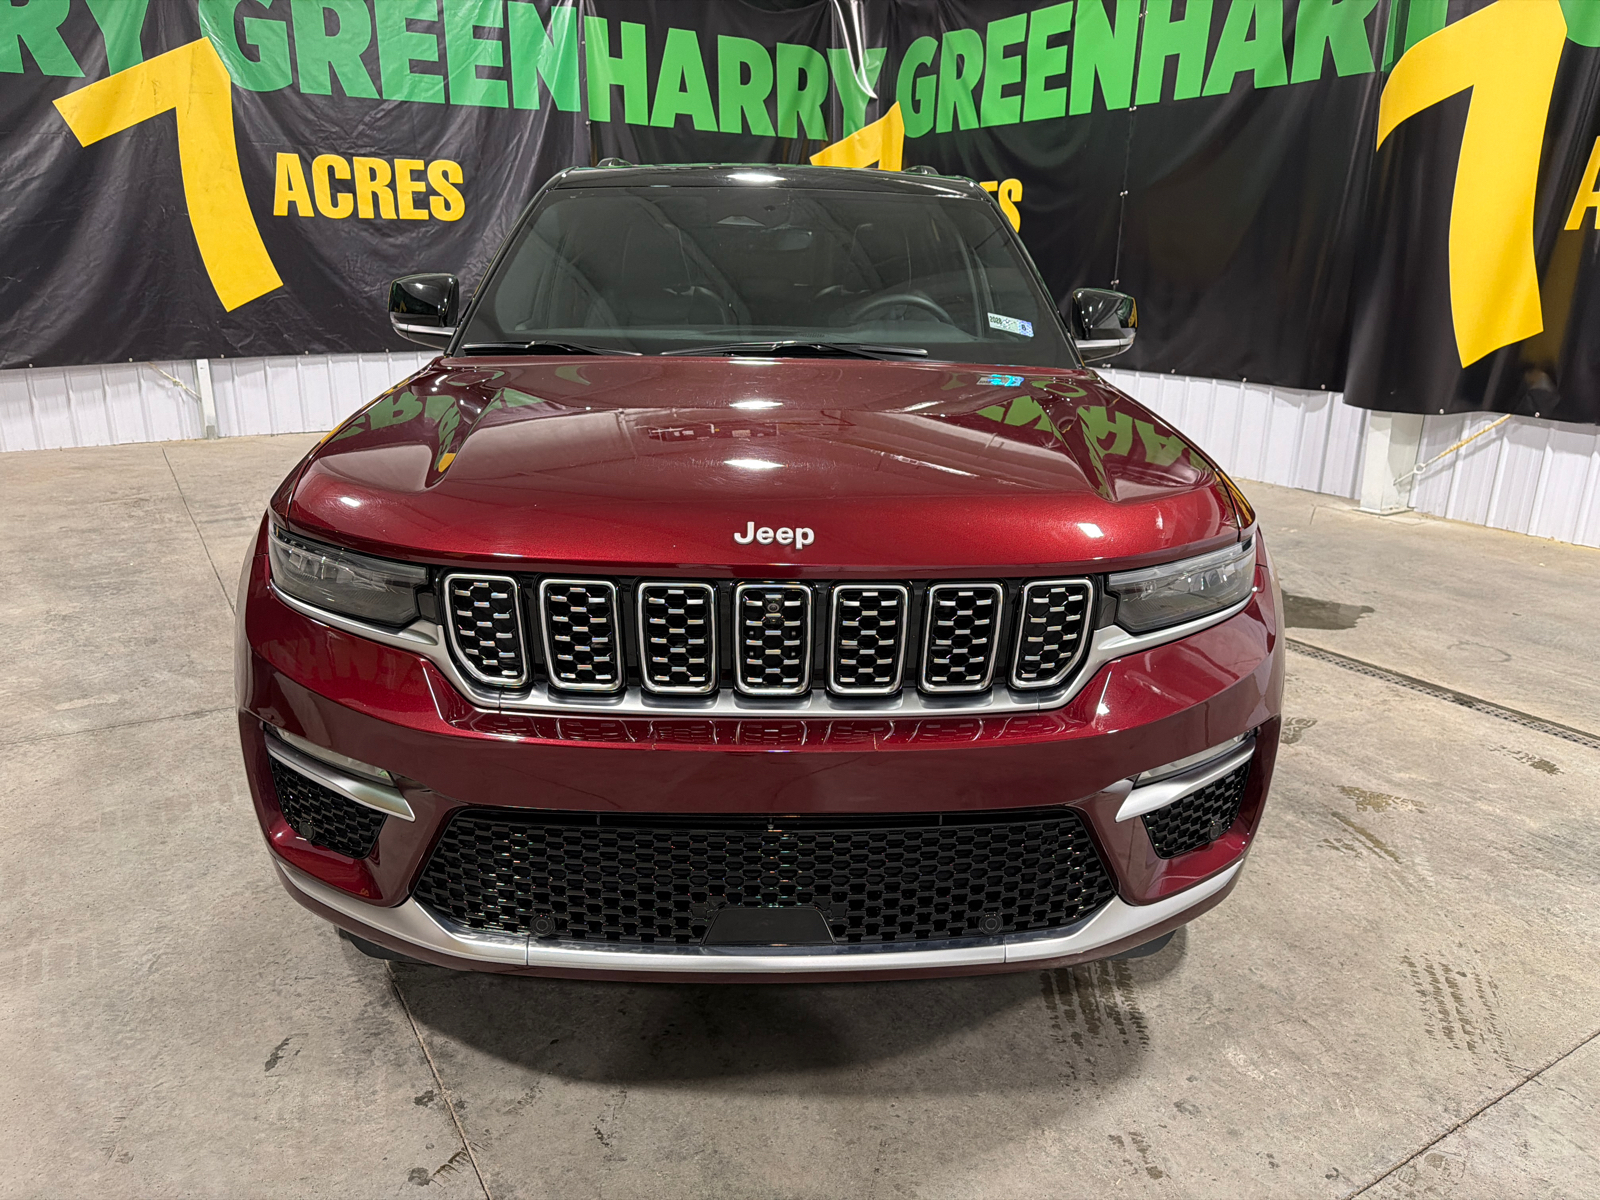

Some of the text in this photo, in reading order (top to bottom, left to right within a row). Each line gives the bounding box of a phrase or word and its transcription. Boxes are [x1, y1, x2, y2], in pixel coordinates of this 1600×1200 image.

[198, 0, 578, 112] GREEN
[584, 15, 888, 140] HARRY
[896, 0, 1142, 138] GREEN
[52, 36, 466, 312] 7 ACRES
[1376, 0, 1568, 368] 7
[733, 521, 815, 550] Jeep
